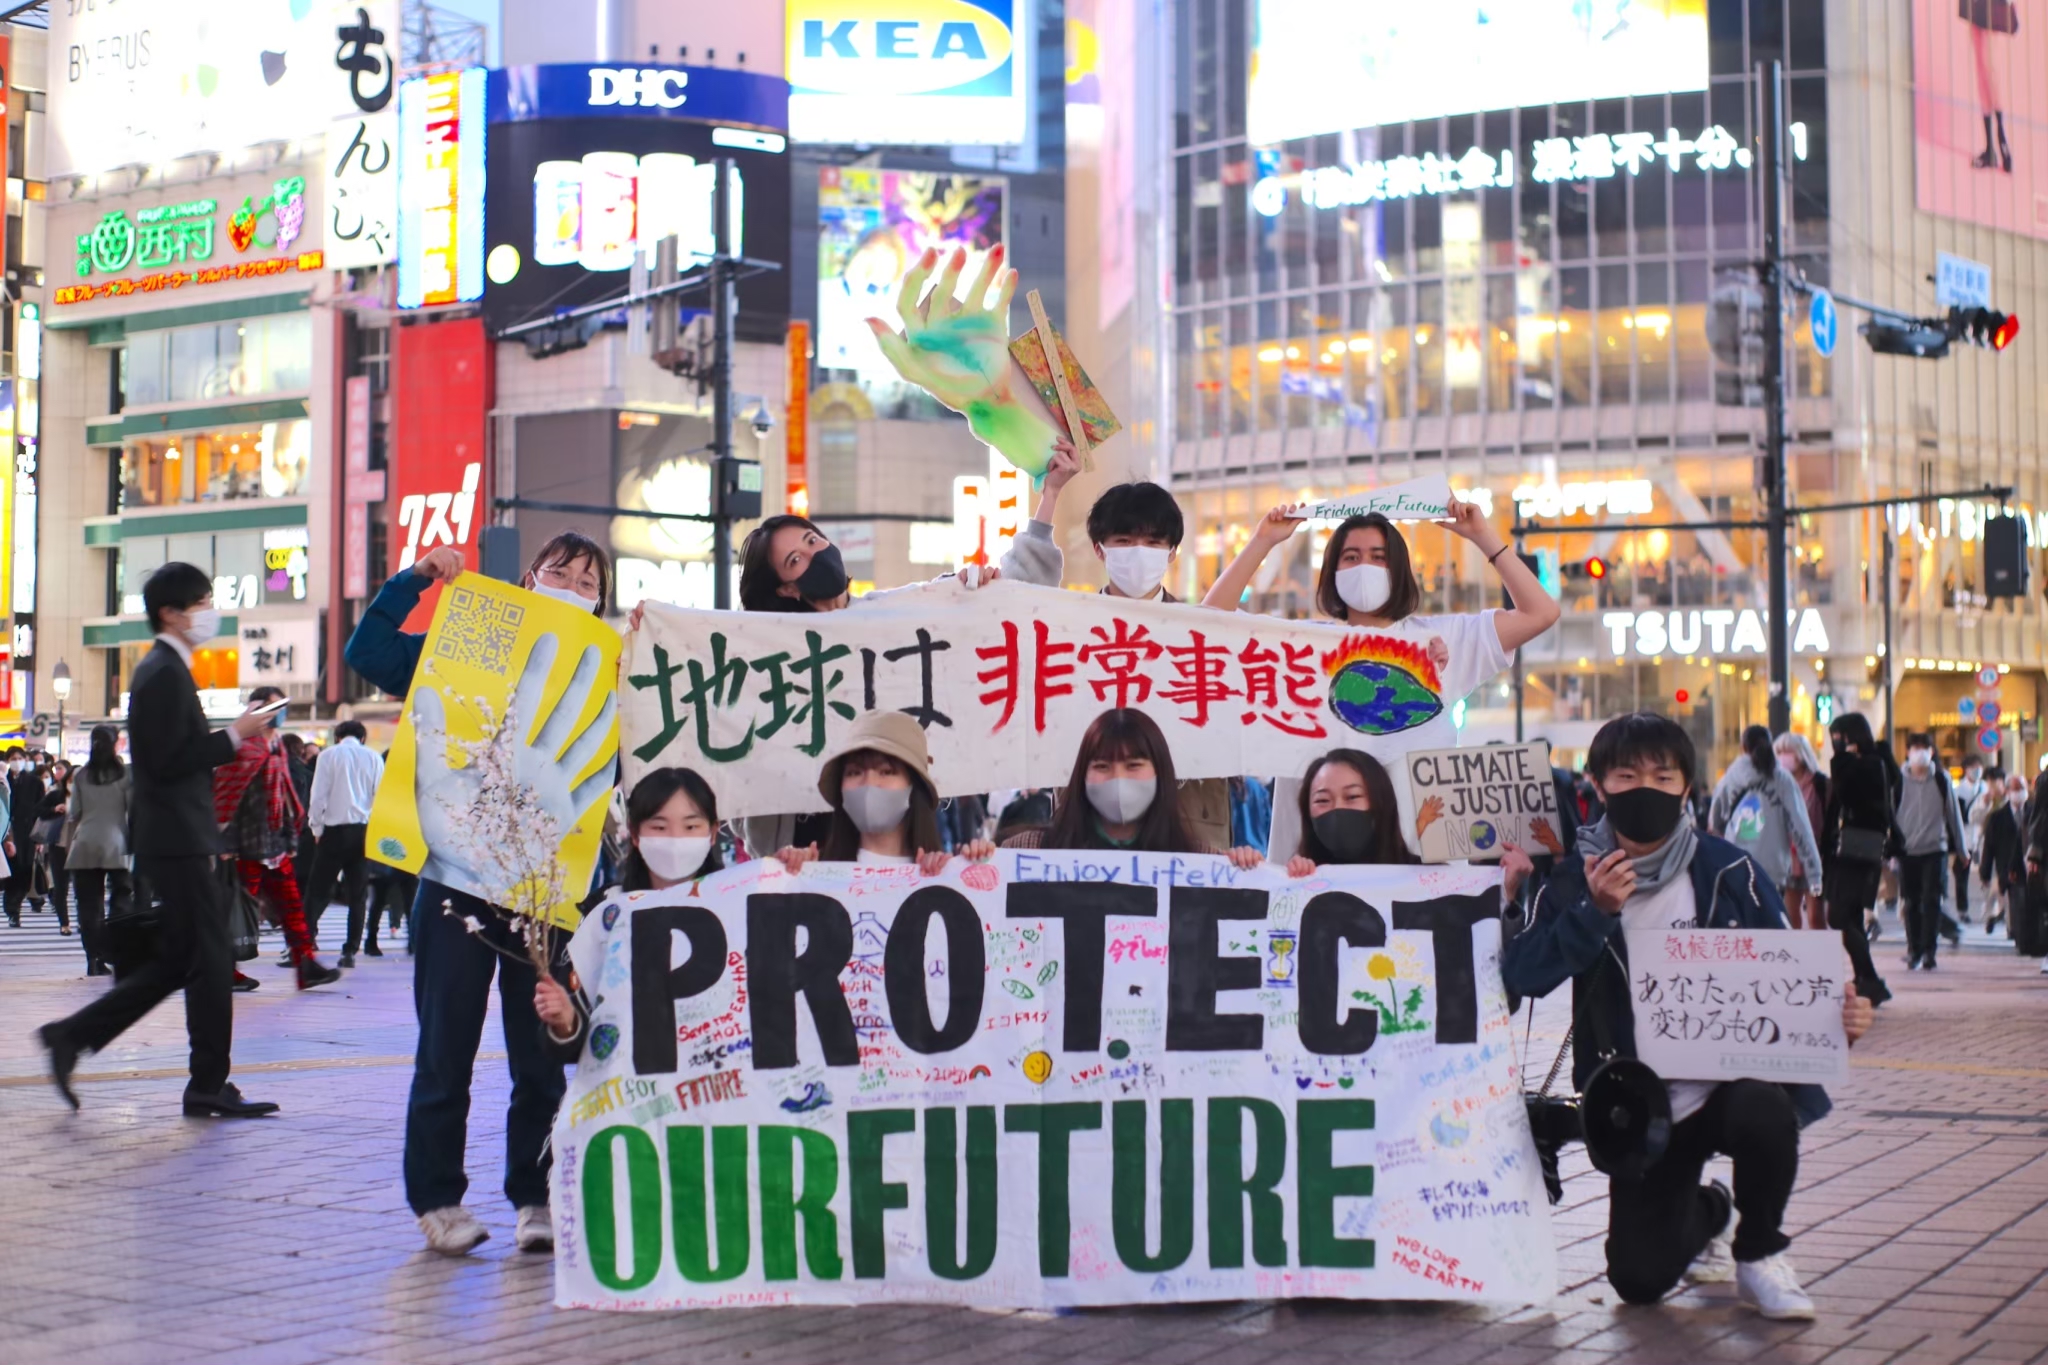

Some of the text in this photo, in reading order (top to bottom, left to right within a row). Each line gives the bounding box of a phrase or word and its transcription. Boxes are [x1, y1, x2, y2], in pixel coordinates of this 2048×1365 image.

[588, 69, 687, 108] DHC
[1395, 494, 1448, 516] Future
[1603, 608, 1830, 656] TSUTAA
[628, 617, 1327, 763] 地球は非常事態
[1412, 748, 1535, 787] CLIMATE
[1451, 781, 1557, 816] JUSTICE
[1664, 934, 1800, 963] 気候危機の今、
[631, 884, 1502, 1076] PROTECT
[675, 1068, 749, 1113] FUTURE
[582, 1124, 843, 1291] OUR
[846, 1096, 1376, 1281] FUTURE
[1423, 1262, 1485, 1294] EARTH
